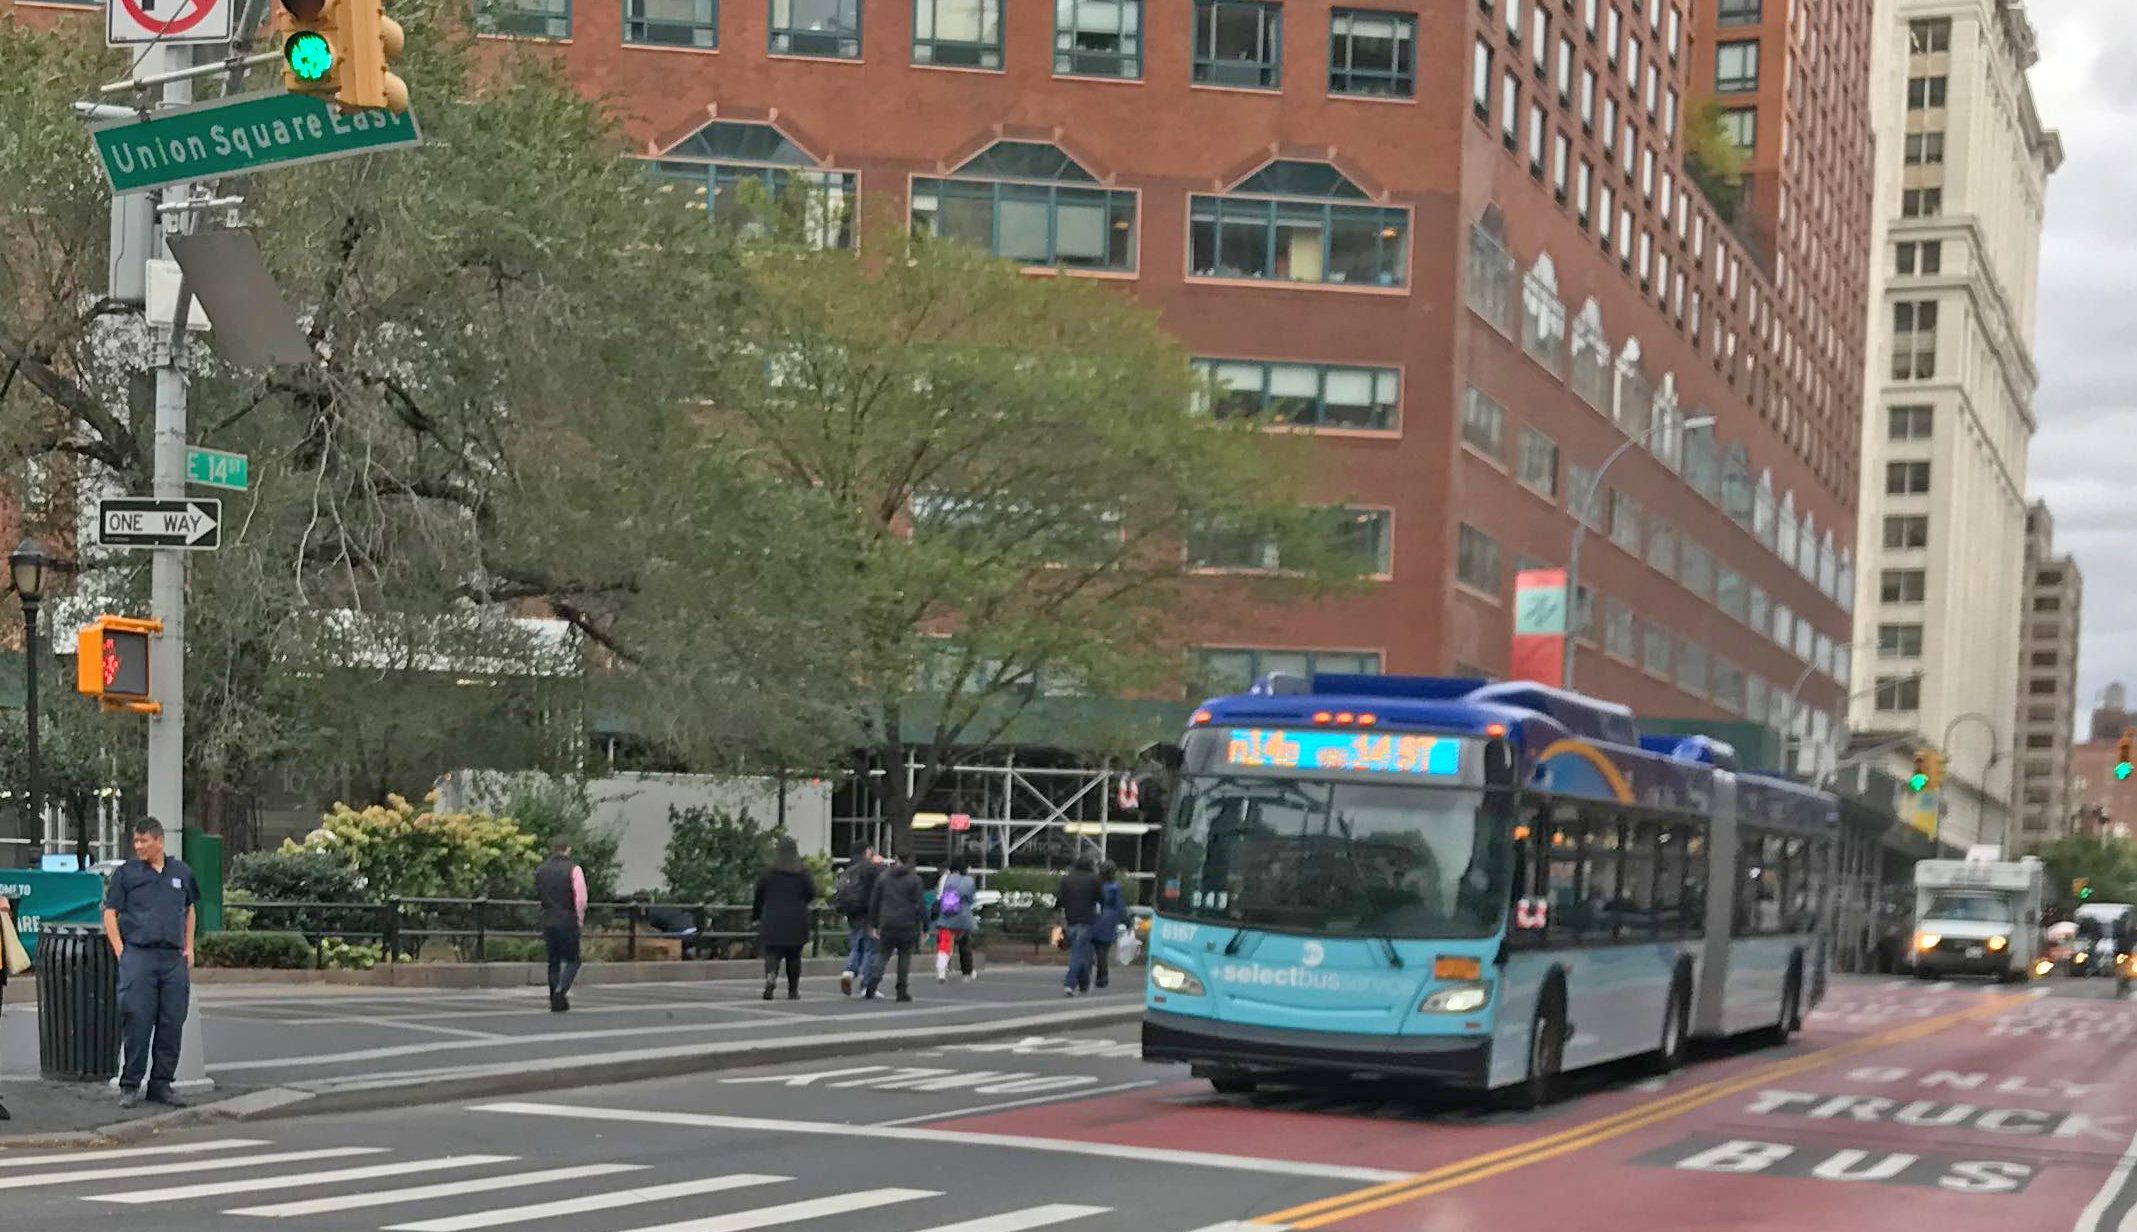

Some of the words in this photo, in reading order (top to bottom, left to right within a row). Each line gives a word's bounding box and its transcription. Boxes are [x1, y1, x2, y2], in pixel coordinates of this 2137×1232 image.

[110, 134, 207, 175] Union
[209, 111, 323, 160] Square
[187, 452, 200, 479] E
[207, 454, 228, 484] 14
[108, 513, 144, 532] ONE
[163, 513, 202, 533] WAY
[18, 883, 32, 896] TO
[1845, 1066, 2104, 1099] ONLY
[1743, 1089, 2128, 1140] TRUCK
[1675, 1139, 2032, 1193] BUS
